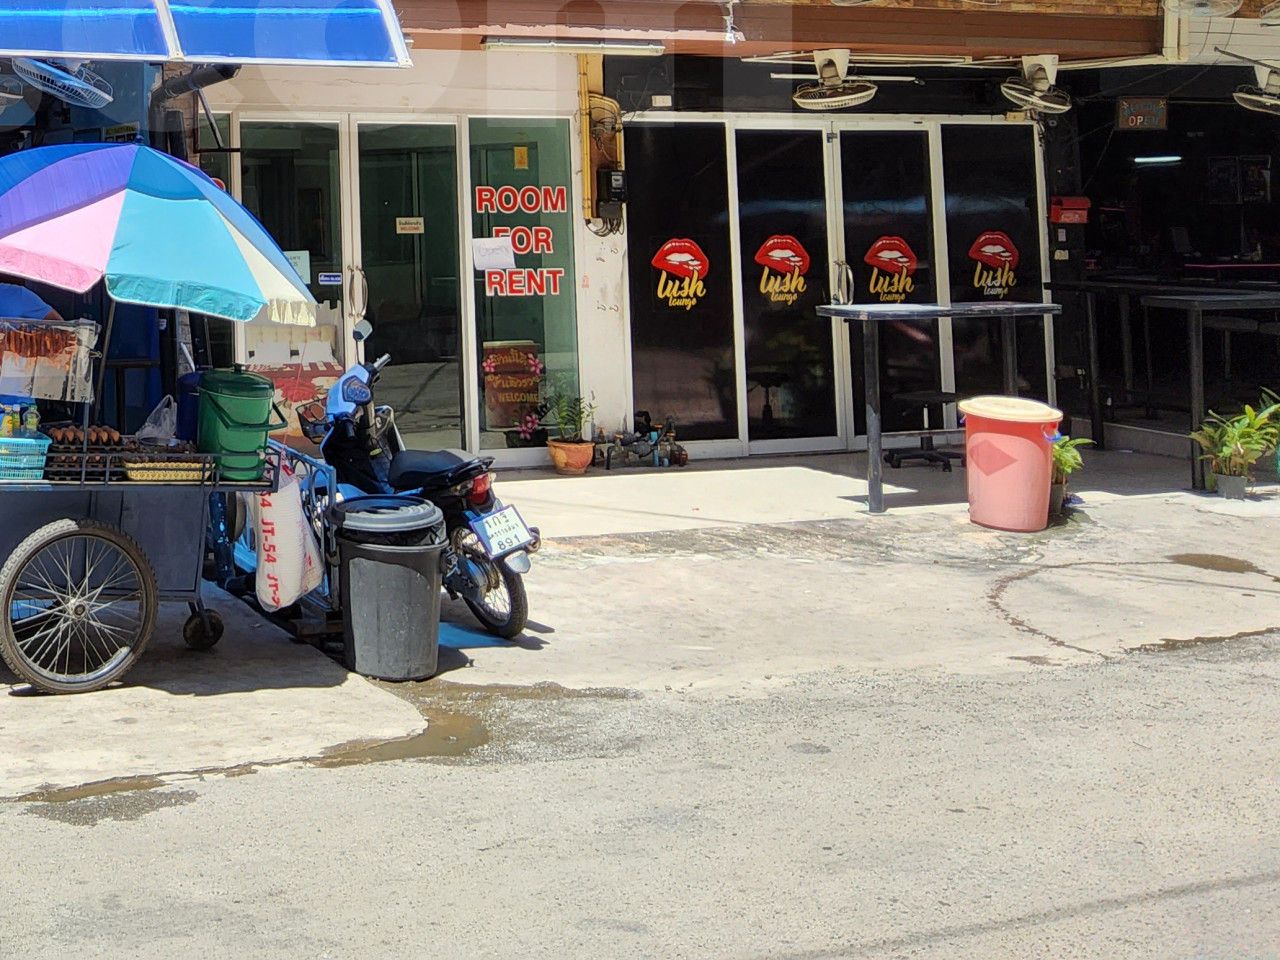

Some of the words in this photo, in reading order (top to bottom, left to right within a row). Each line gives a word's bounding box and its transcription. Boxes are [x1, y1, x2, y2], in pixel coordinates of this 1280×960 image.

[475, 186, 567, 213] ROOM
[485, 269, 564, 296] RENT
[657, 269, 706, 298] lush
[759, 265, 807, 294] lush
[869, 267, 914, 294] lush
[973, 261, 1017, 288] lush
[668, 295, 697, 310] lounge
[770, 291, 798, 306] lounge
[879, 290, 906, 303] lounge
[983, 285, 1009, 300] lounge
[261, 519, 277, 564] JT-54
[497, 533, 521, 550] 891
